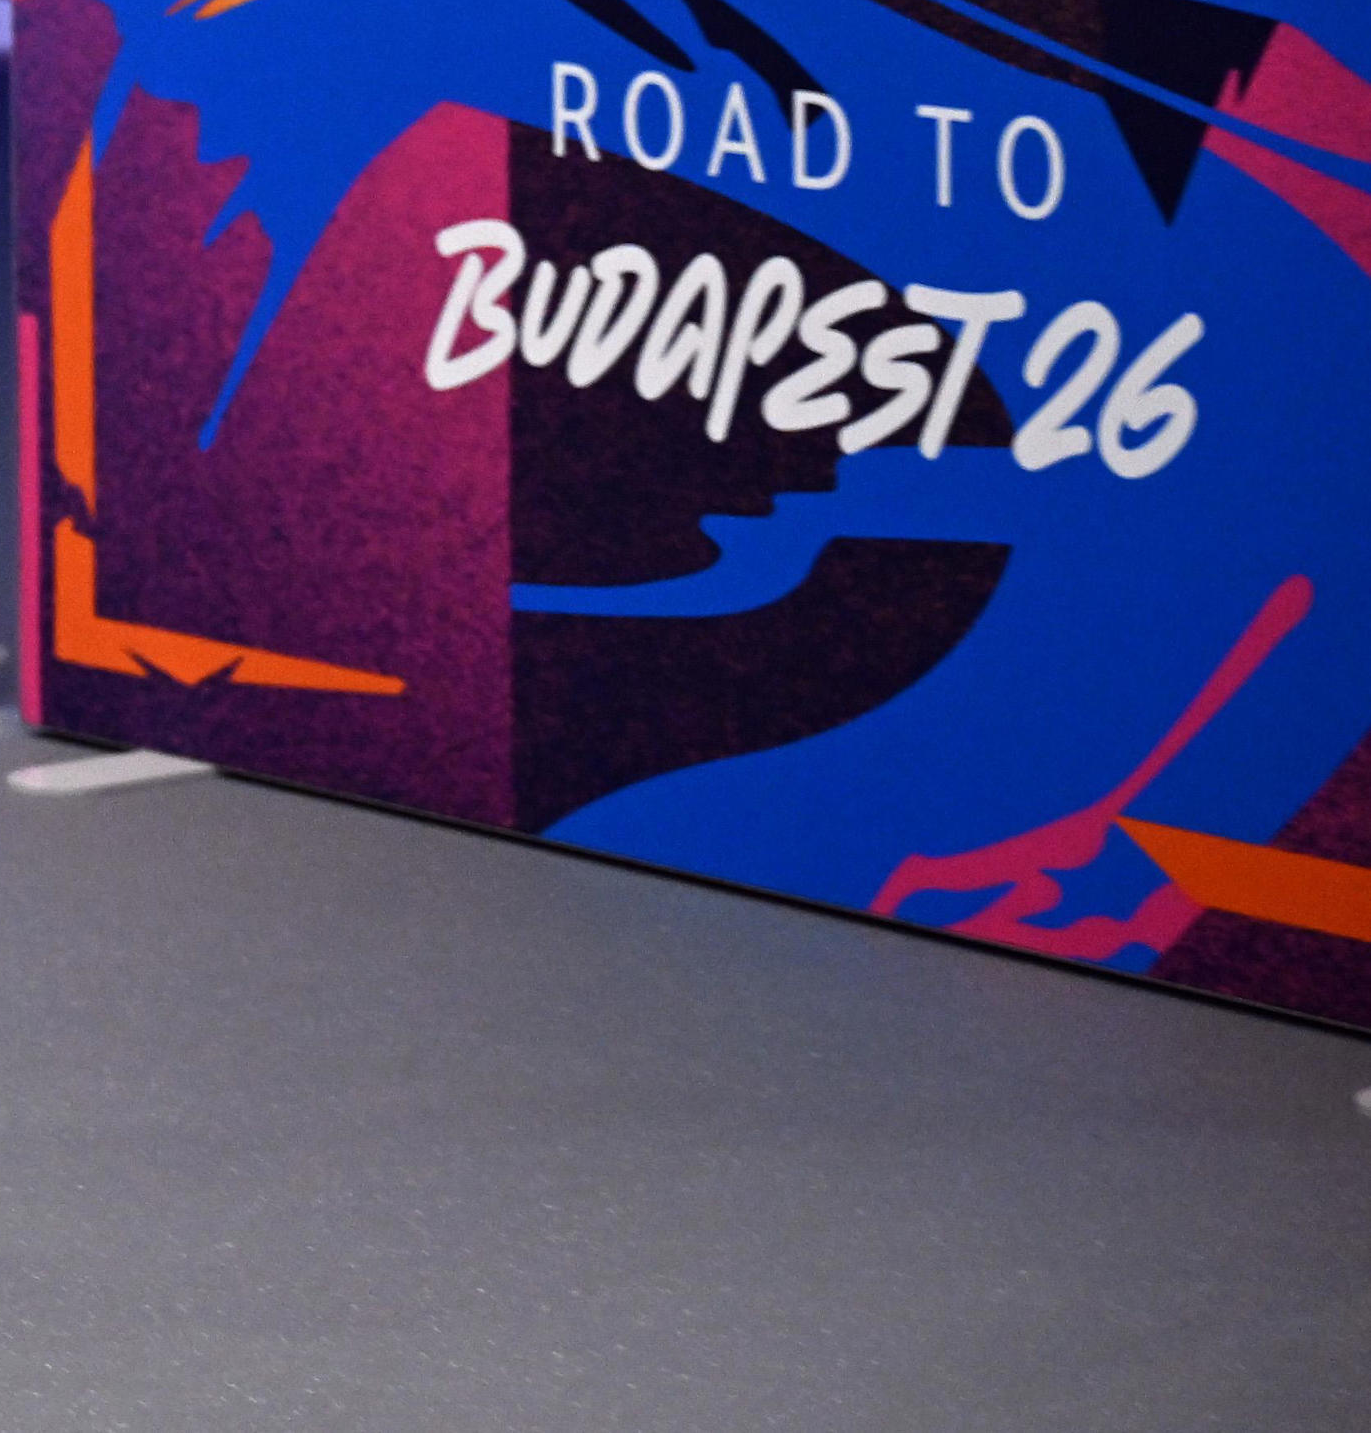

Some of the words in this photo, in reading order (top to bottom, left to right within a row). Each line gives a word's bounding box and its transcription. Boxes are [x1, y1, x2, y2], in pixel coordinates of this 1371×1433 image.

[550, 60, 853, 191] ROAD
[914, 102, 1066, 221] TO
[425, 217, 1027, 460] BUDAPEST
[1012, 300, 1205, 480] 26
